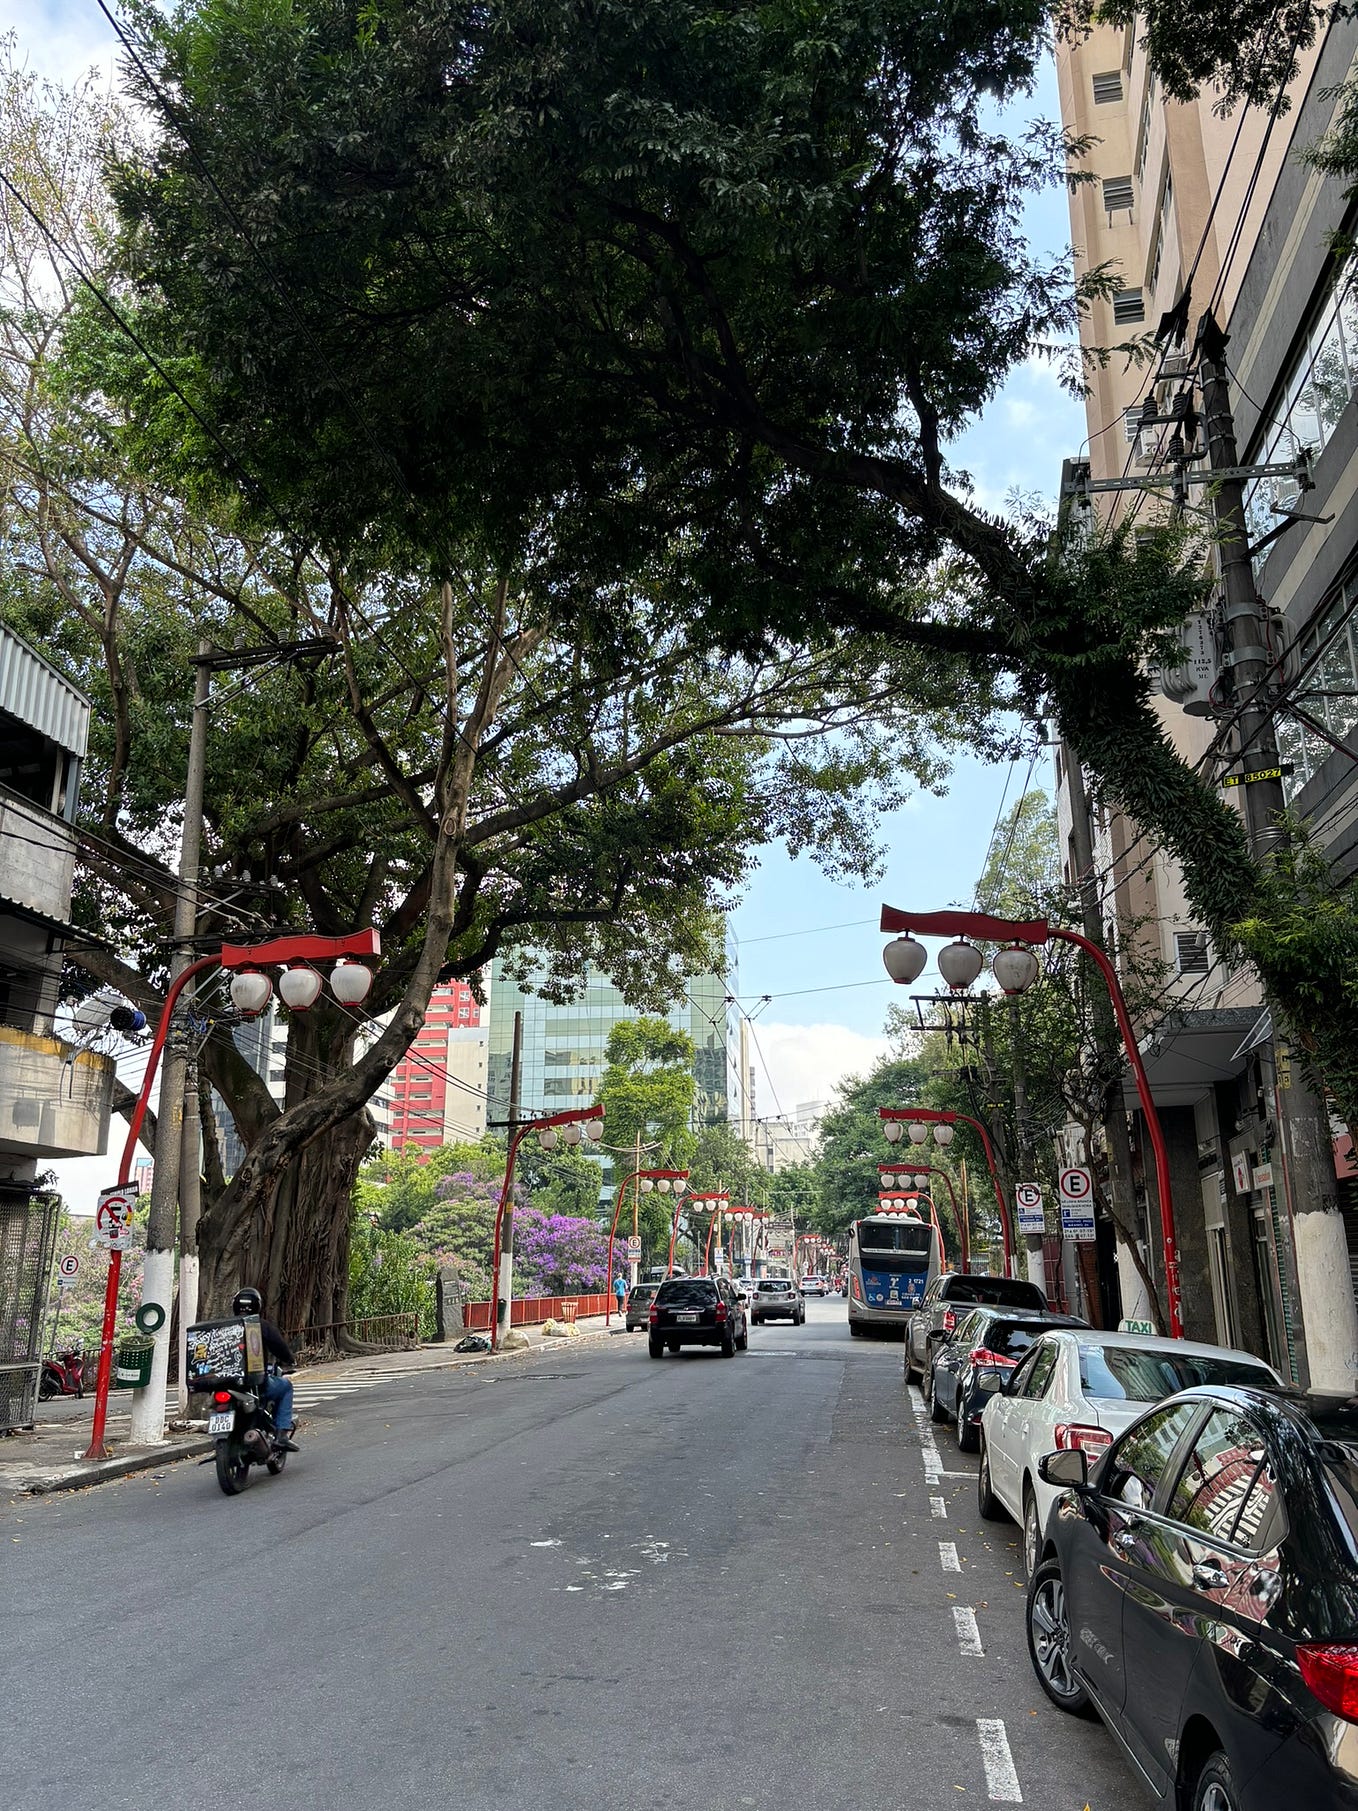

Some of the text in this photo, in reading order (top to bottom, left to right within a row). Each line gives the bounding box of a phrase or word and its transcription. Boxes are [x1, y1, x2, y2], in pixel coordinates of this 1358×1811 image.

[1224, 768, 1281, 787] ET 85027
[1070, 1176, 1081, 1192] E
[1025, 1190, 1034, 1202] E
[66, 1259, 74, 1271] E
[1124, 1319, 1152, 1334] TAXI
